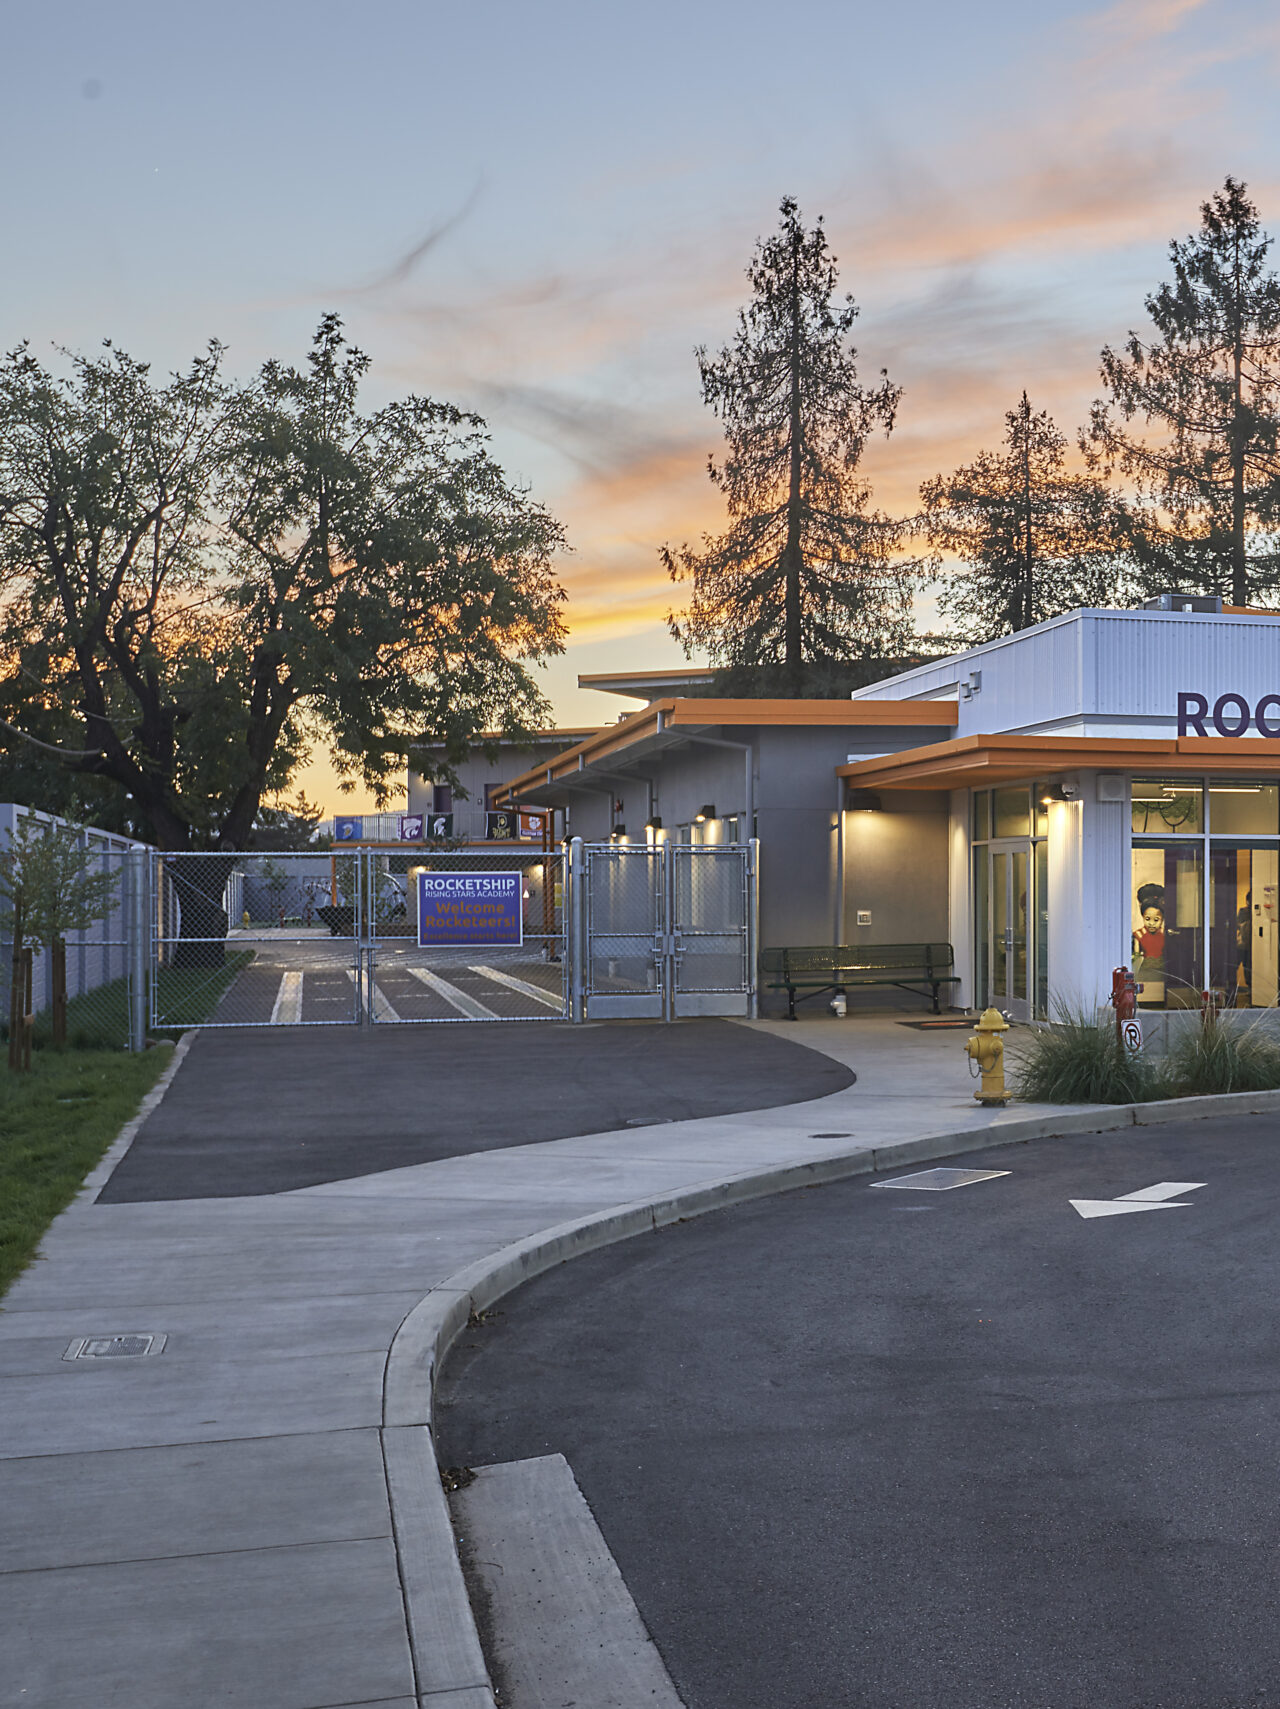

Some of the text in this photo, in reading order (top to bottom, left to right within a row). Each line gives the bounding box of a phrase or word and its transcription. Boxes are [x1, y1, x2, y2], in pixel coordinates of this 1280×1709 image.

[425, 879, 515, 890] ROCKETSHIP
[435, 901, 505, 914] Welcome
[425, 915, 516, 927] Rocketeers!
